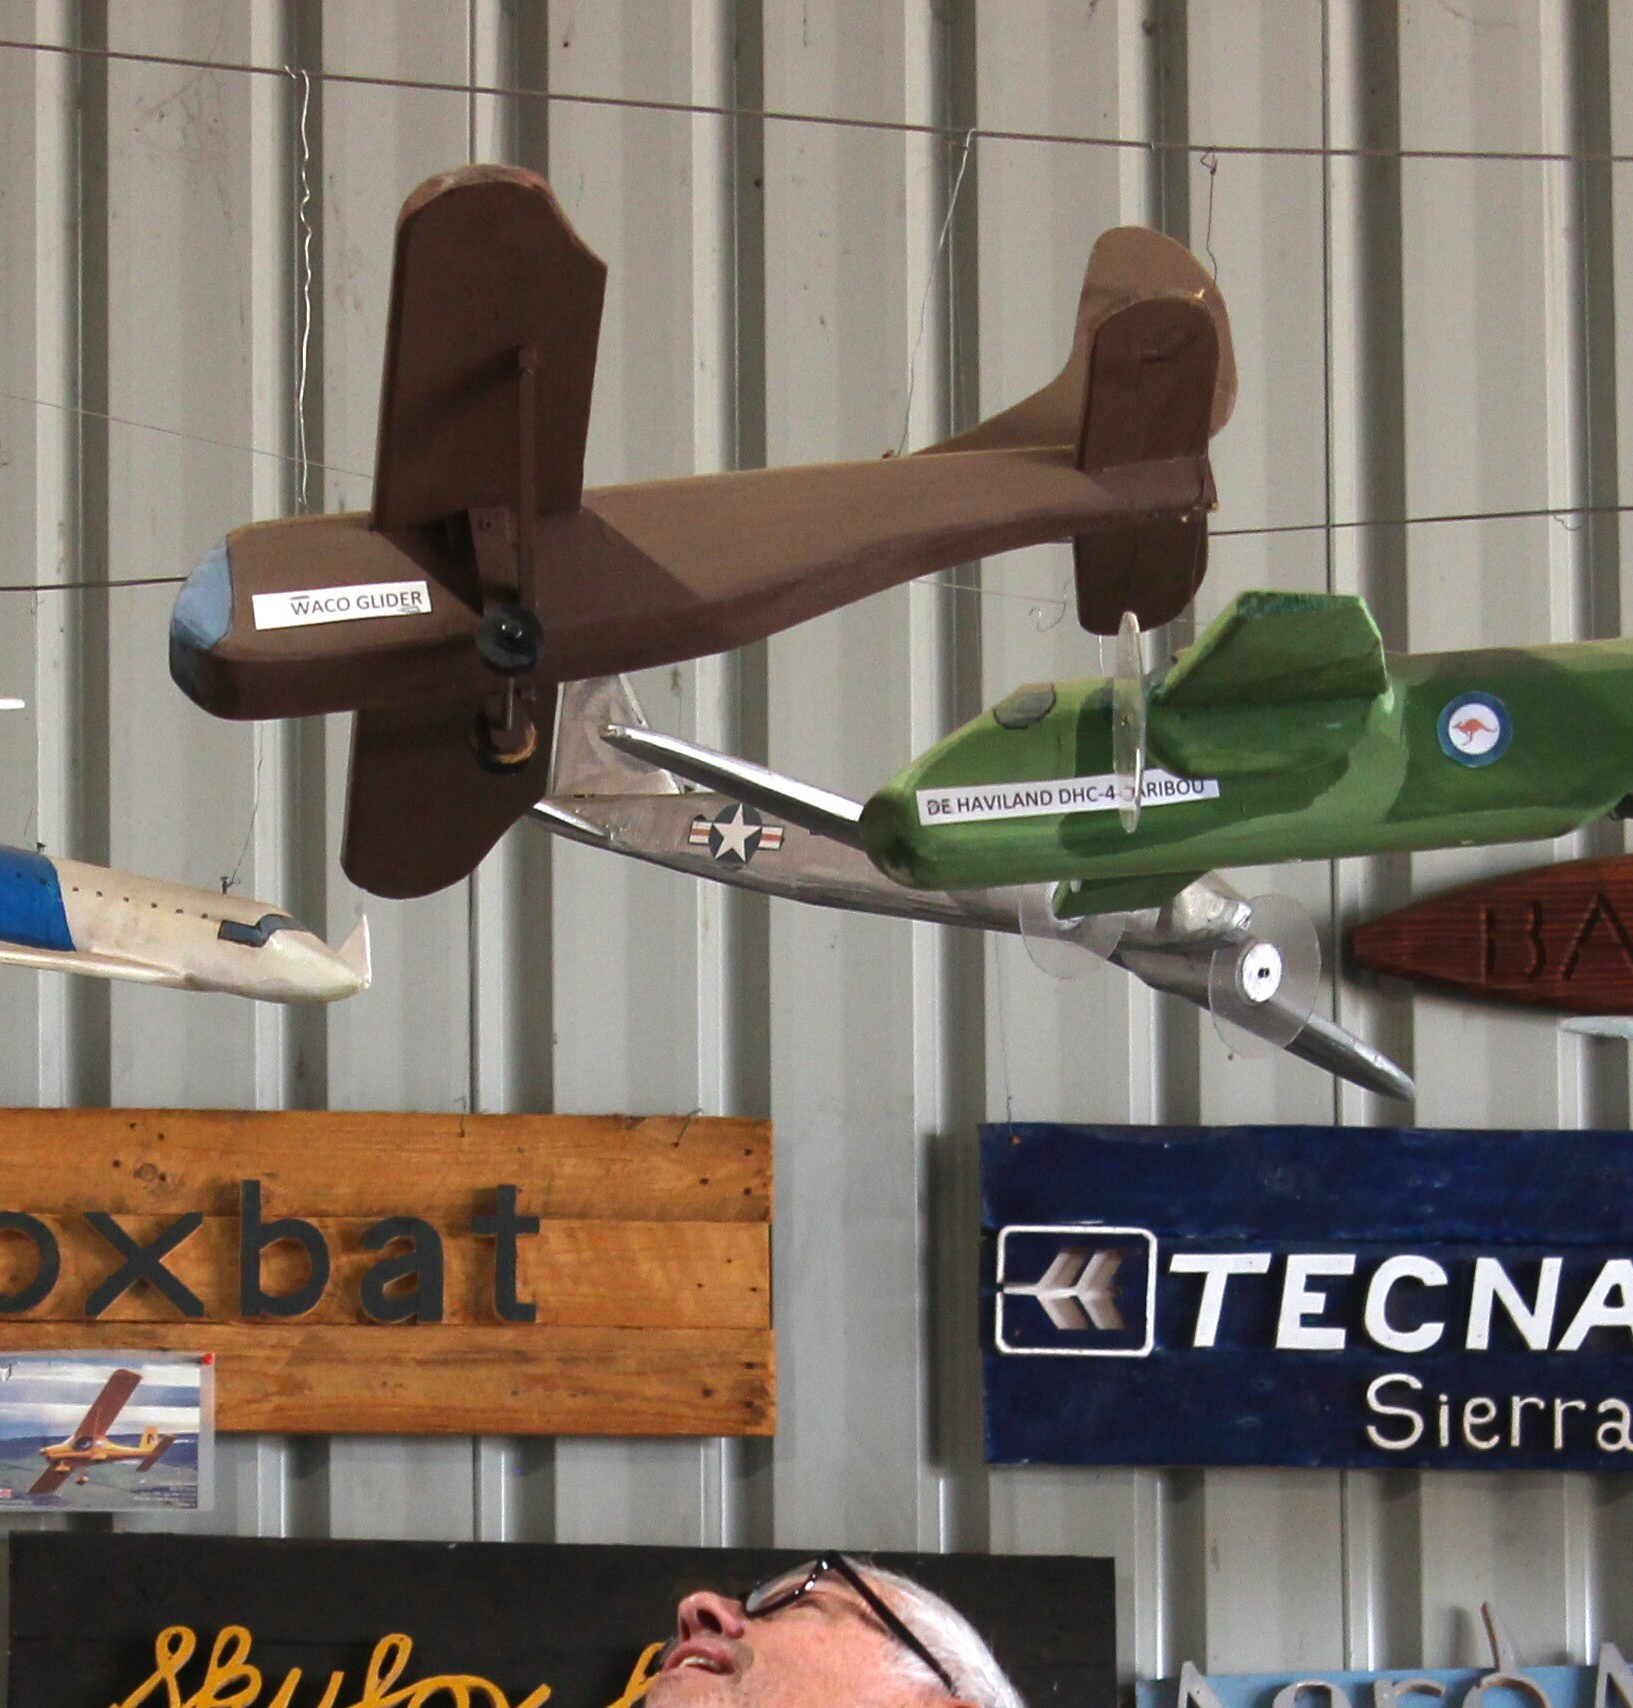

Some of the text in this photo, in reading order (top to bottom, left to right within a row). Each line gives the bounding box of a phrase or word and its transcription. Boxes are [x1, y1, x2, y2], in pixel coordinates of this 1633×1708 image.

[290, 591, 424, 616] WACO GLIDER
[926, 779, 1205, 816] DE HAVILAND DHC-4 RIBOU
